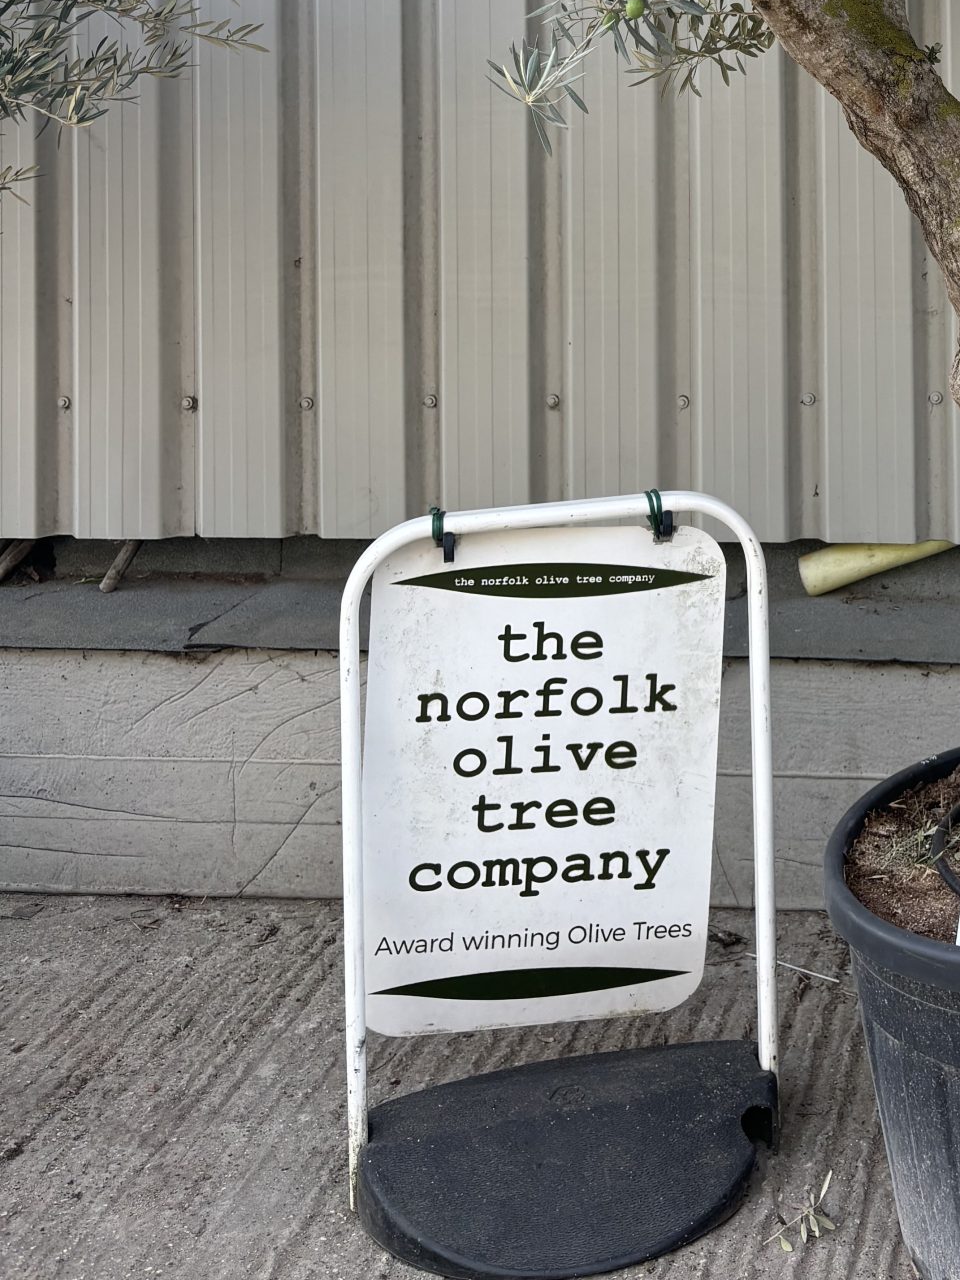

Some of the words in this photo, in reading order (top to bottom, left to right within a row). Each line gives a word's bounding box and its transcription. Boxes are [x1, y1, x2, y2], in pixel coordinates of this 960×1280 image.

[454, 577, 475, 587] the
[481, 575, 529, 586] norfolk
[535, 575, 570, 585] olive
[576, 575, 603, 584] tree
[608, 574, 655, 585] company
[497, 621, 604, 663] the
[415, 673, 678, 723] norfolk
[452, 733, 637, 778] olive
[471, 794, 616, 833] tree
[408, 848, 671, 898] company
[374, 932, 454, 956] Award
[462, 927, 560, 951] winning
[567, 923, 626, 945] Olive
[632, 921, 692, 941] Trees
